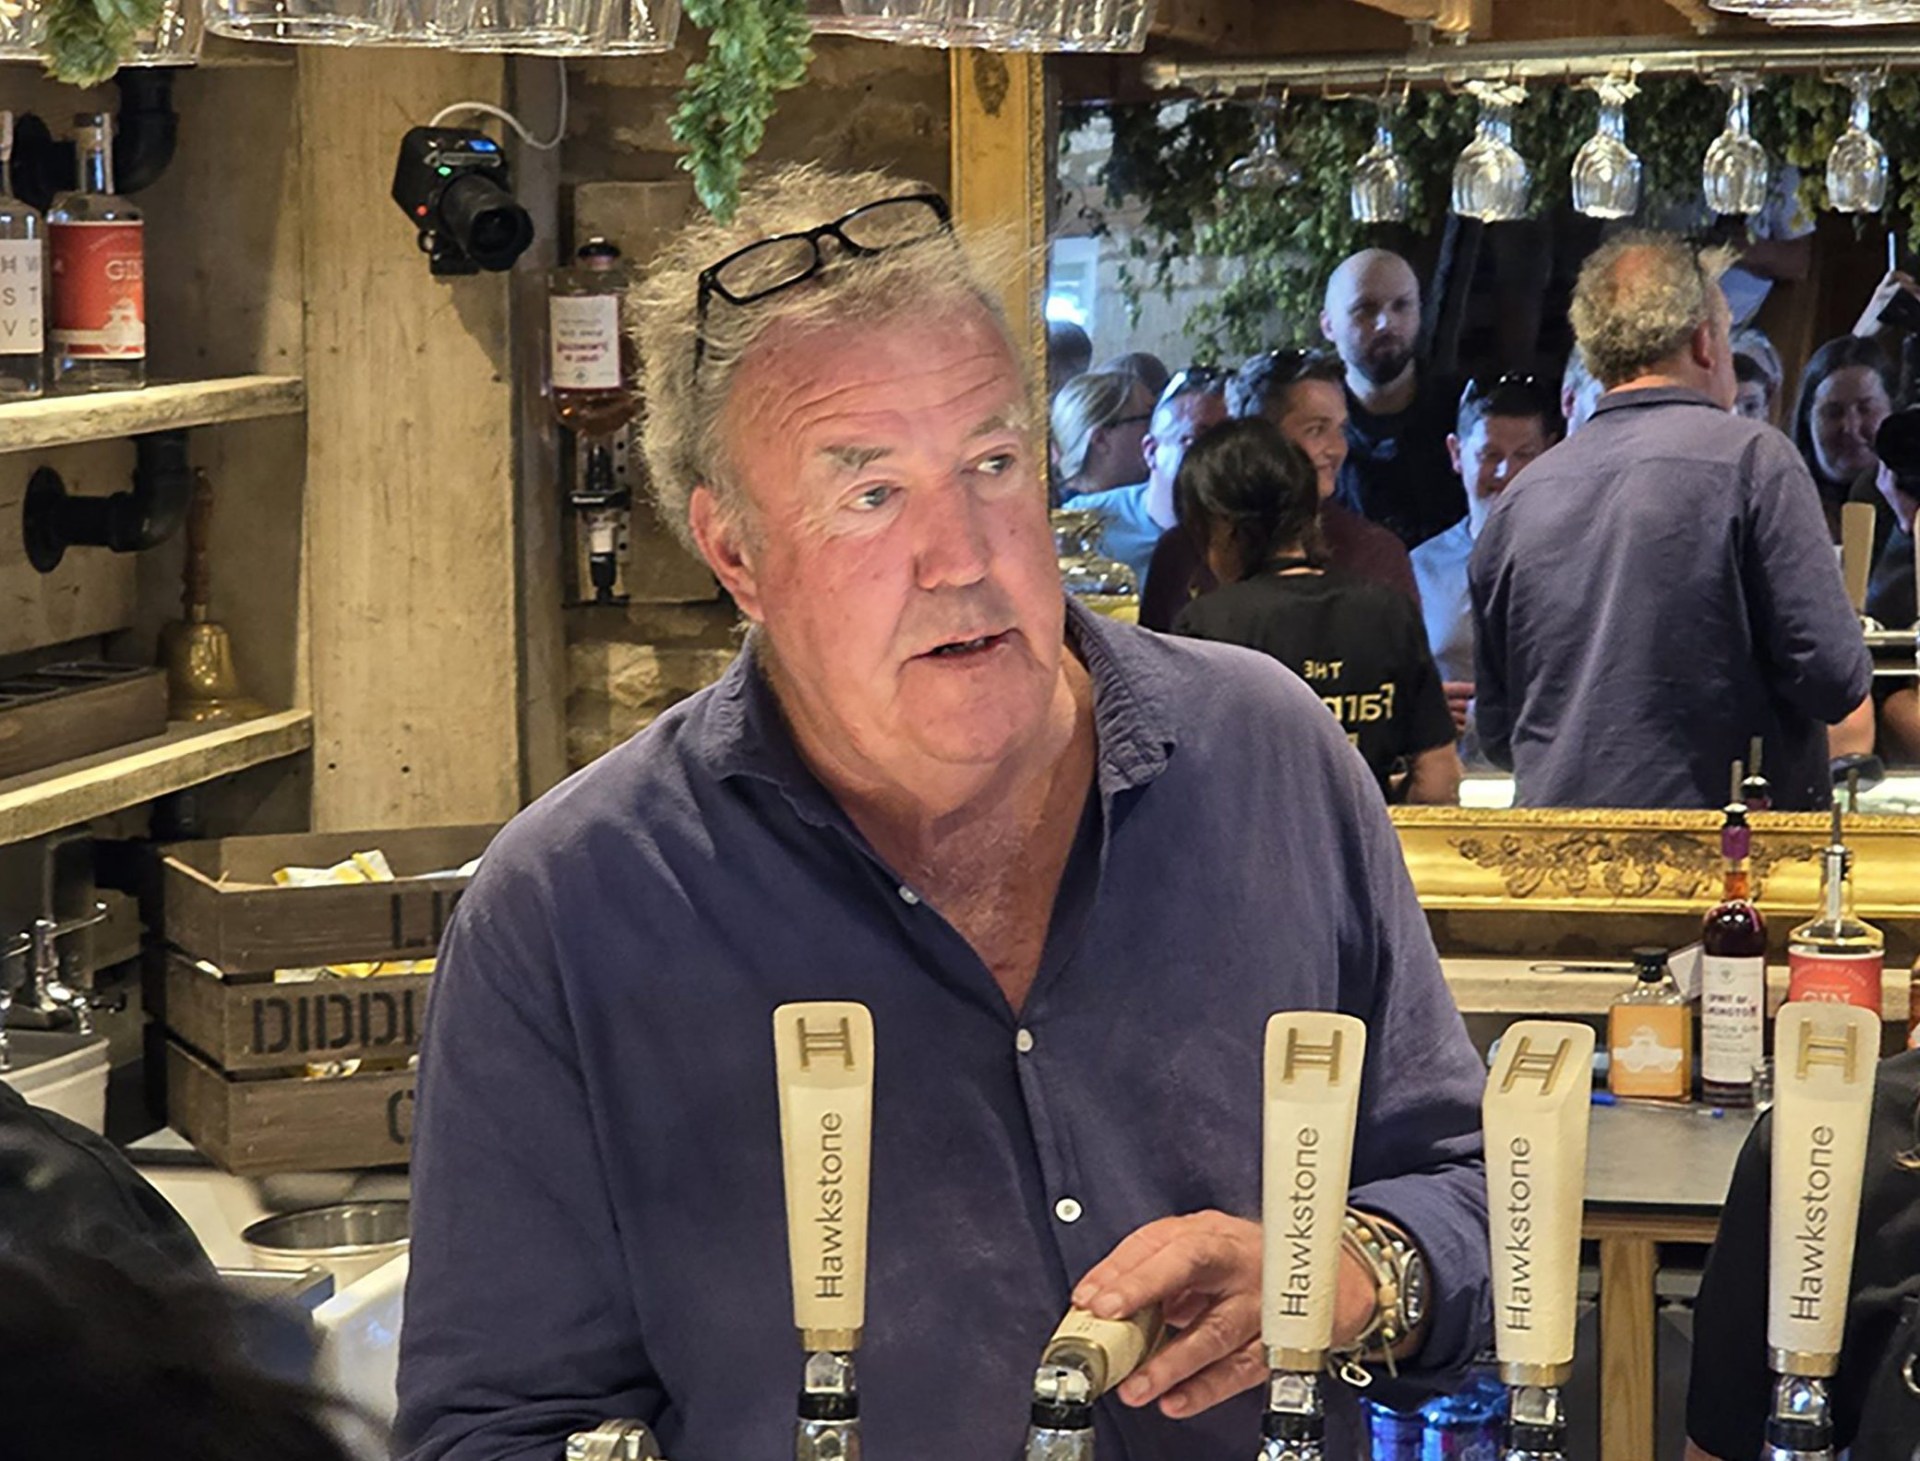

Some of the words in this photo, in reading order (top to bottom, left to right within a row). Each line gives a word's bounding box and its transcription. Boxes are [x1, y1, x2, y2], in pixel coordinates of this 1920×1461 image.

[815, 1112, 843, 1299] Hawkstone
[1280, 1127, 1319, 1317] Hawkstone
[1506, 1137, 1531, 1331] Hawkstone
[1790, 1125, 1834, 1321] Hawkstone
